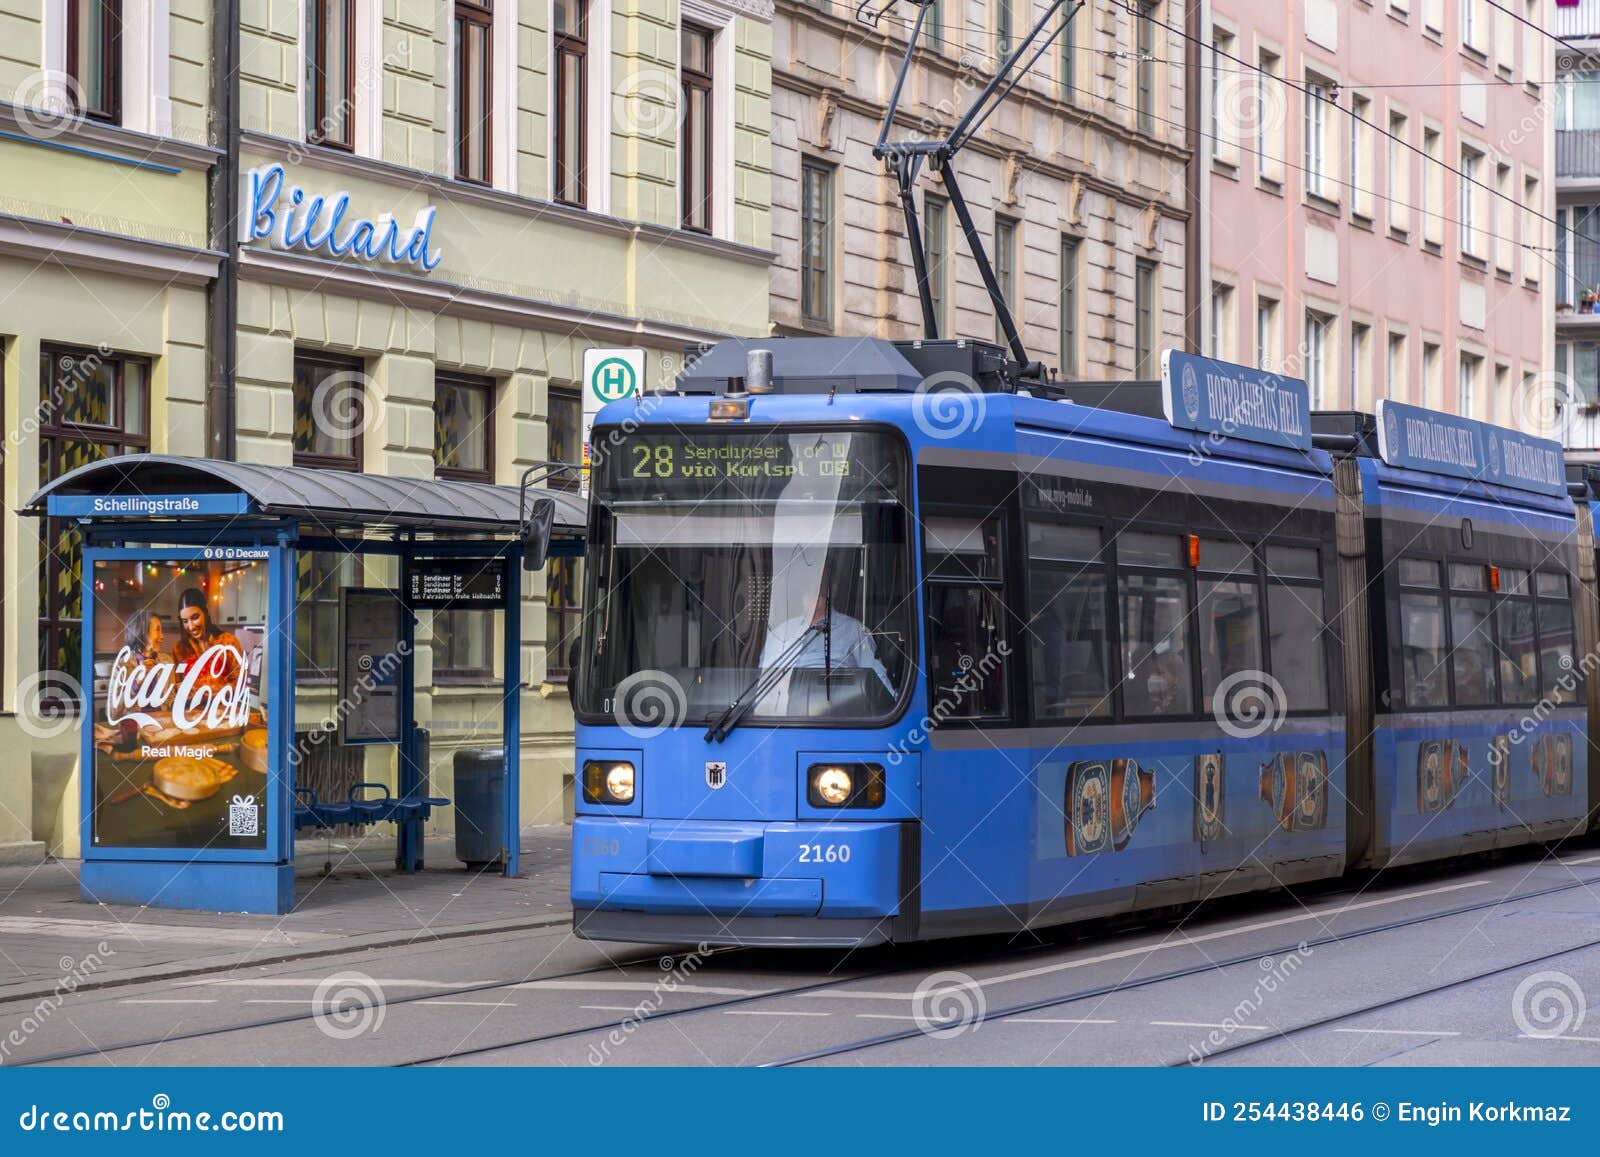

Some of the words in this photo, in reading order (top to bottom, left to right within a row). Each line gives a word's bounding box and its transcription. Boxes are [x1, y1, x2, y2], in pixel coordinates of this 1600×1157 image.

[249, 164, 442, 270] Billard
[603, 368, 624, 394] H
[1206, 373, 1278, 432] HOFBRÄUHAUS
[1278, 389, 1303, 435] HELL
[684, 443, 784, 459] Sendlinger
[1406, 416, 1459, 465] HOFBRÄUHAUS
[1459, 430, 1477, 468] HELL
[632, 445, 674, 477] 28
[681, 463, 717, 477] via
[94, 498, 199, 513] Schellingstraße
[236, 549, 269, 559] Decaux
[141, 745, 171, 758] Real
[174, 745, 214, 760] Magic
[798, 844, 851, 863] 2160
